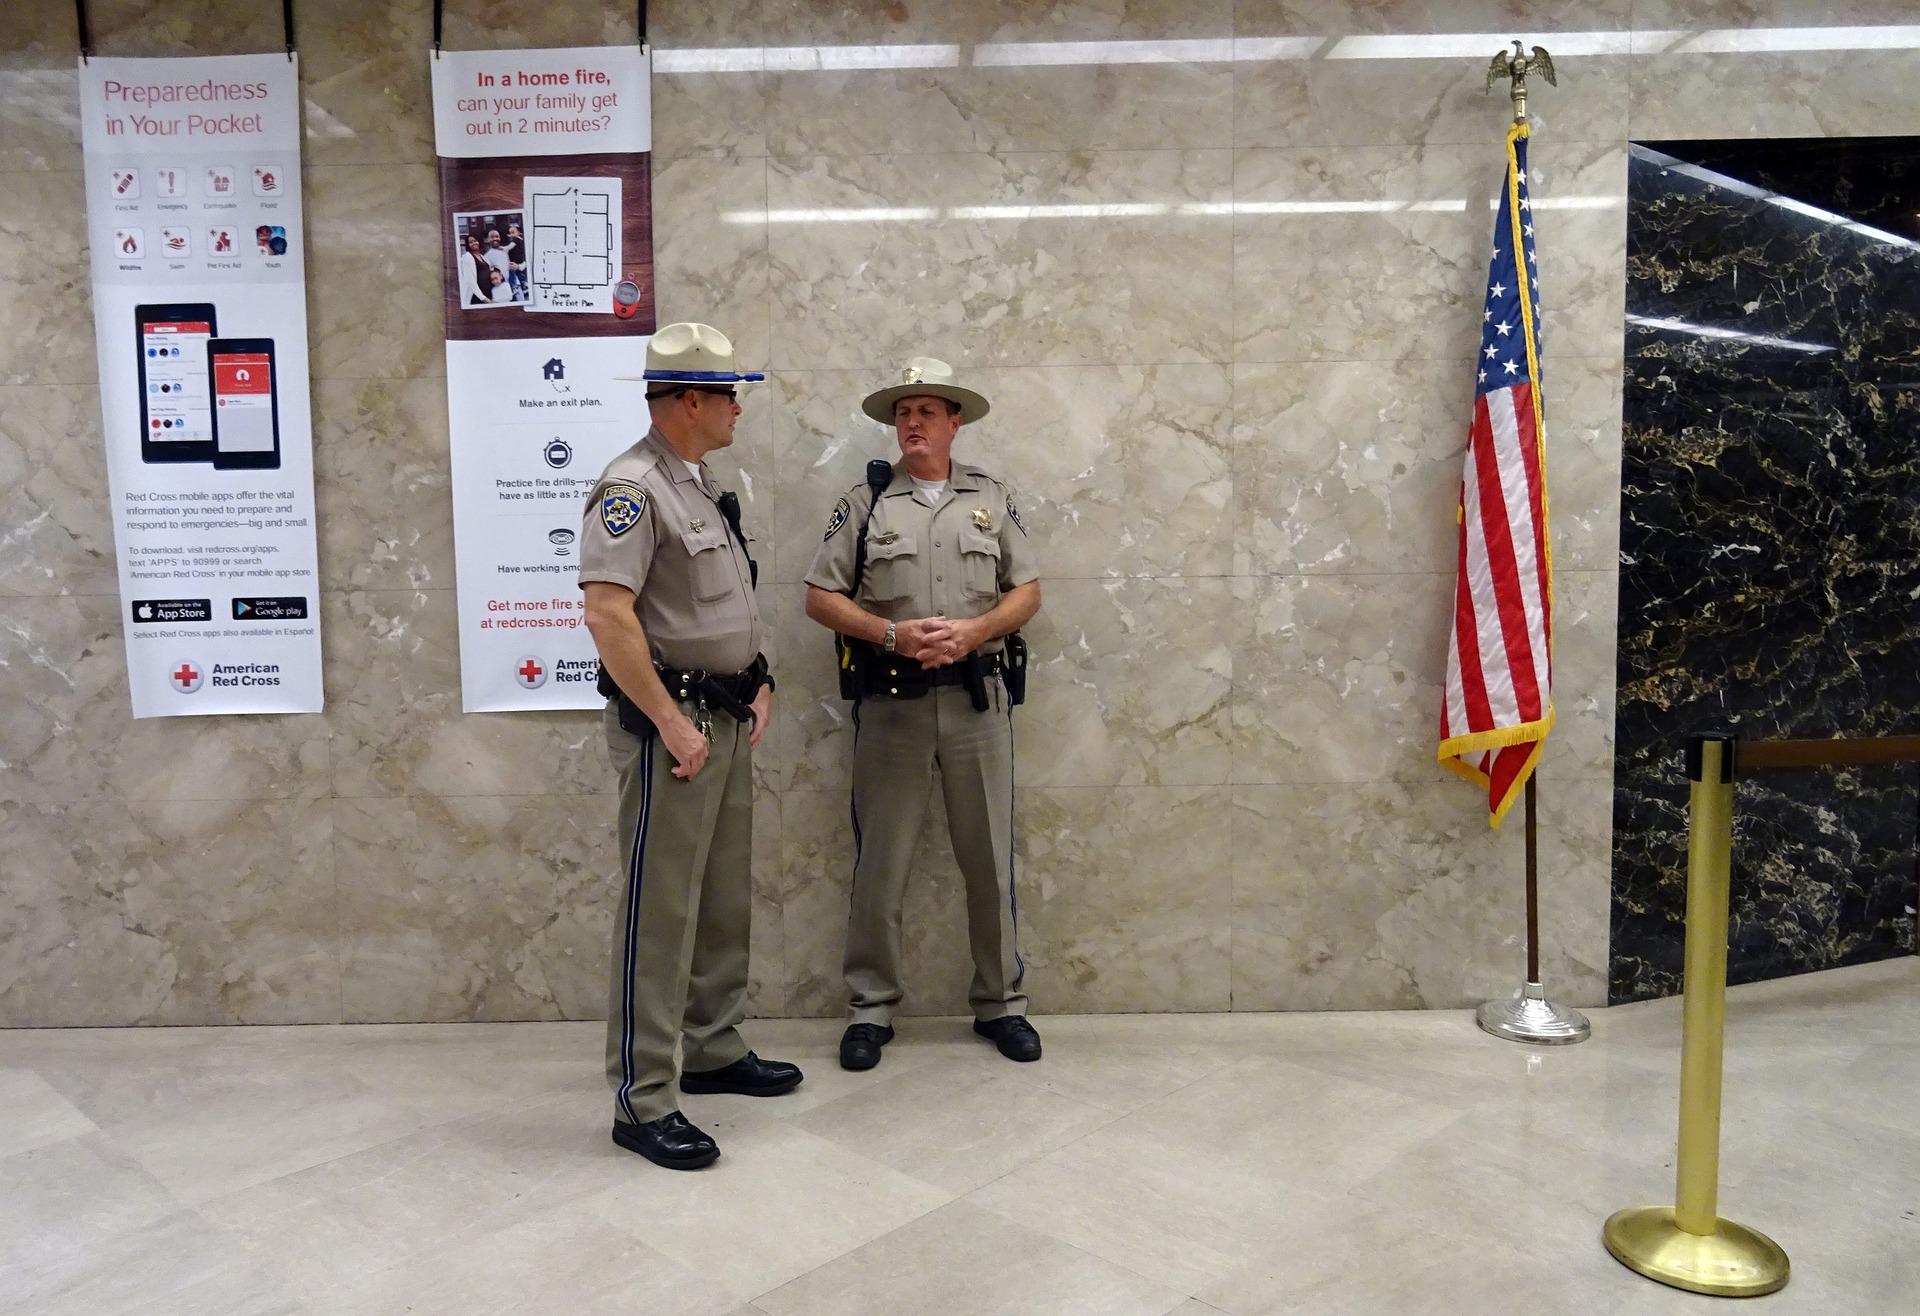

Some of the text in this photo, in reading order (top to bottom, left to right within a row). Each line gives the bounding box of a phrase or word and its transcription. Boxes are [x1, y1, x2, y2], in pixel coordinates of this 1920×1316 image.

[478, 69, 611, 87] In a home fire,
[104, 80, 268, 108] Preparedness
[457, 92, 618, 115] can your family get
[106, 113, 263, 136] in Your Pocket
[466, 115, 611, 136] out in 2 minutes?
[560, 399, 577, 407] exit
[580, 398, 602, 408] plan.
[535, 479, 550, 487] fire
[126, 490, 295, 502] Red Cross mobile apps offer the vital
[499, 492, 521, 500] have
[537, 490, 556, 498] little
[573, 490, 579, 498] 2
[126, 505, 292, 517] information you need to prepare and
[127, 520, 167, 531] respond
[169, 521, 179, 530] to
[265, 519, 282, 527] and
[129, 547, 139, 555] To
[193, 558, 220, 566] 90999
[497, 564, 521, 573] Have
[523, 563, 560, 573] working
[228, 570, 245, 579] your
[275, 569, 290, 578] app
[488, 600, 511, 611] Get
[514, 602, 548, 610] more
[552, 598, 573, 609] fire
[157, 608, 206, 620] App Store
[255, 607, 302, 618] Google play
[480, 616, 584, 629] at redcross.org/
[202, 630, 222, 638] apps
[212, 663, 280, 675] American
[556, 658, 598, 670] Ameri
[212, 674, 281, 688] Red Cross
[556, 671, 582, 682] Red
